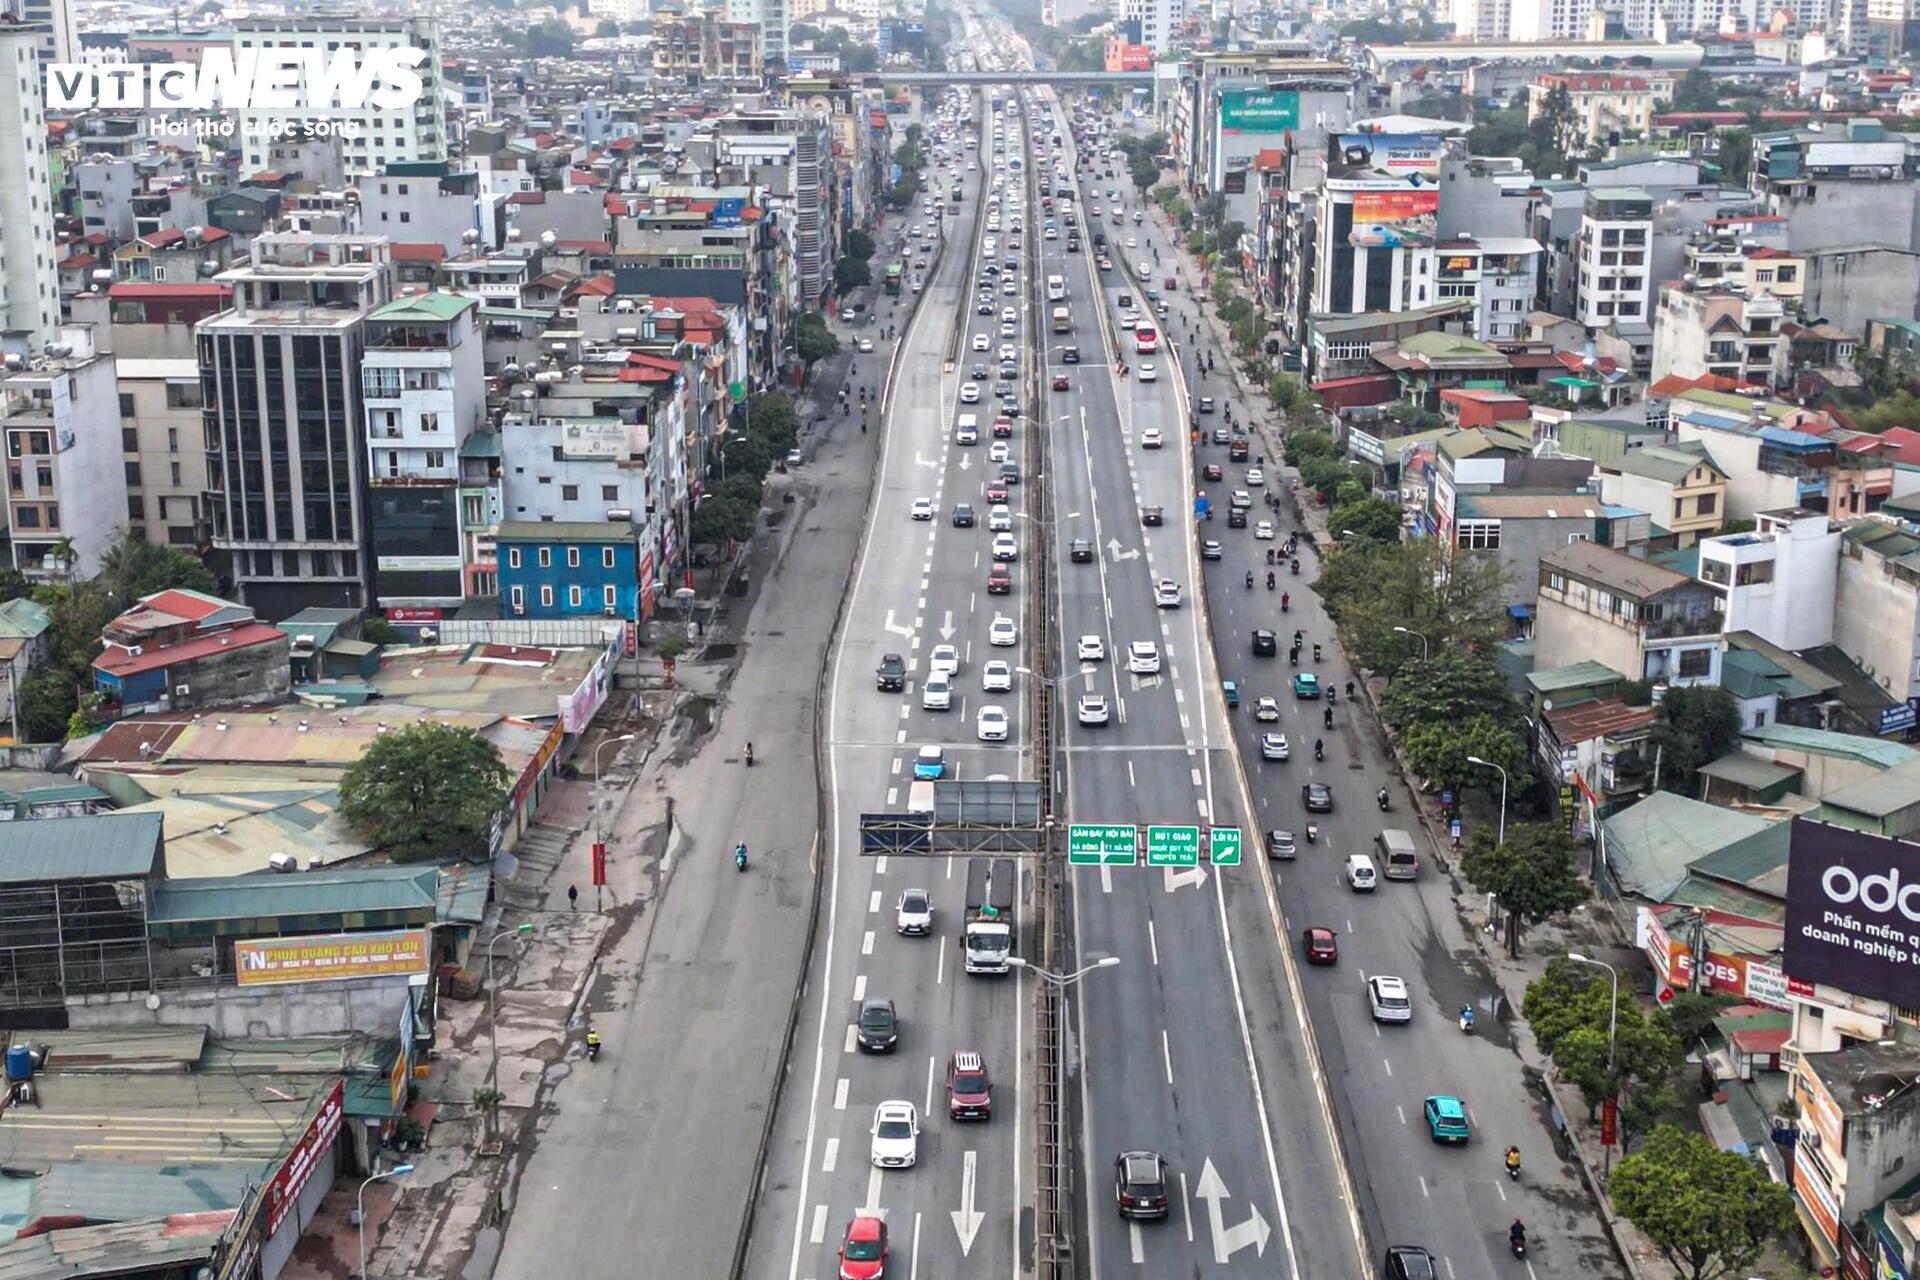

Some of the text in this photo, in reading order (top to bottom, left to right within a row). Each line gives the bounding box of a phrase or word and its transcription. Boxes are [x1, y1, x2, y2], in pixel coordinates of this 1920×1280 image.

[1172, 832, 1192, 842] GIAO
[1801, 924, 1850, 947] doanh
[1853, 939, 1908, 963] nghiệp
